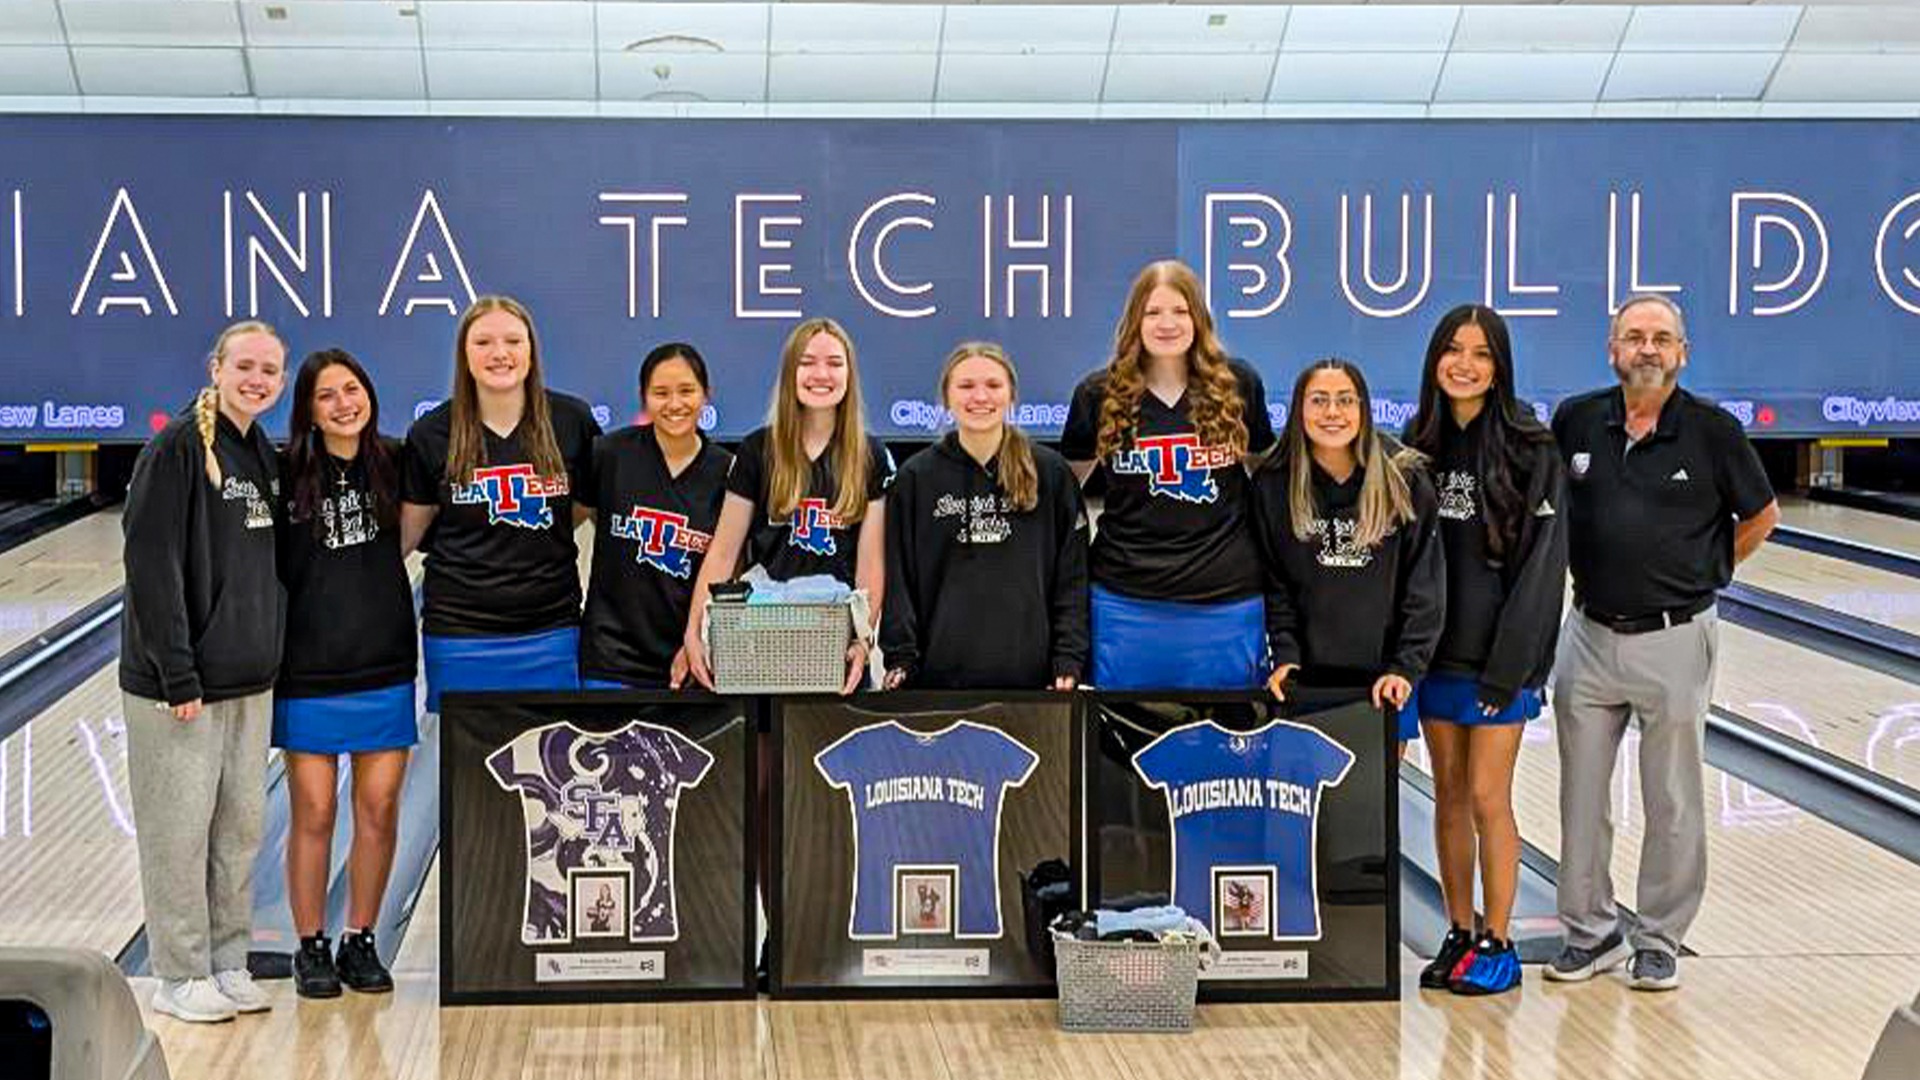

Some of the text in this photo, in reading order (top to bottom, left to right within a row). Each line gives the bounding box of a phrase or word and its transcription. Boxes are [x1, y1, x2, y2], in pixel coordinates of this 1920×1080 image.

[598, 191, 1074, 318] TECH
[43, 402, 124, 427] Lanes
[1113, 450, 1149, 474] LA
[451, 482, 488, 504] LA
[611, 504, 713, 556] LA TEC
[864, 775, 985, 811] LOUISIANA TECH
[1172, 776, 1312, 818] LOUISIANA TECH
